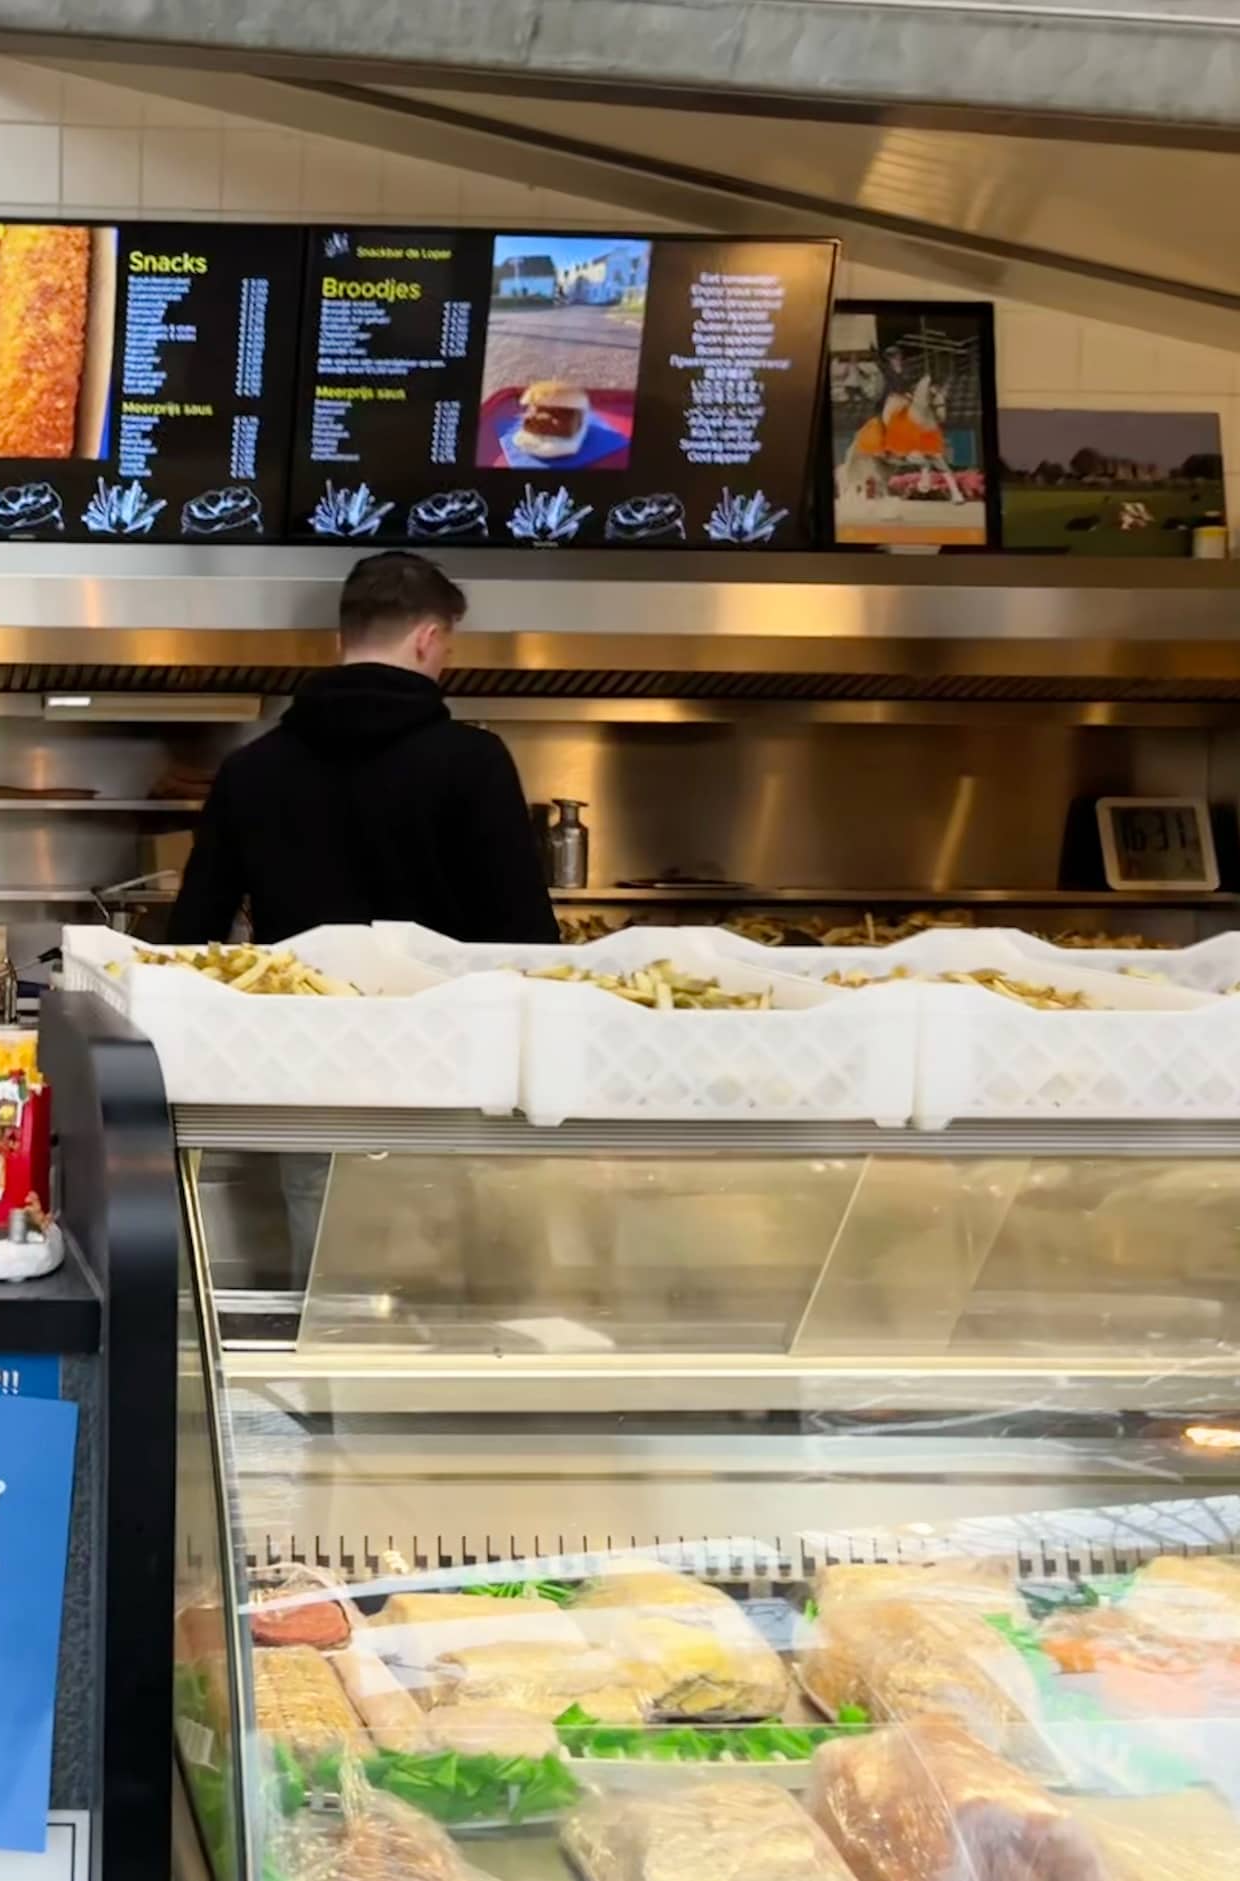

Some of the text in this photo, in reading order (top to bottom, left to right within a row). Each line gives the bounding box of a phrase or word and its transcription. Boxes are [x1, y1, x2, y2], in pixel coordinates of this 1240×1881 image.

[129, 250, 208, 274] Snacks
[322, 277, 422, 303] Broodjes
[315, 385, 407, 401] Meerprijs saus
[121, 401, 214, 418] Meerprijs saus
